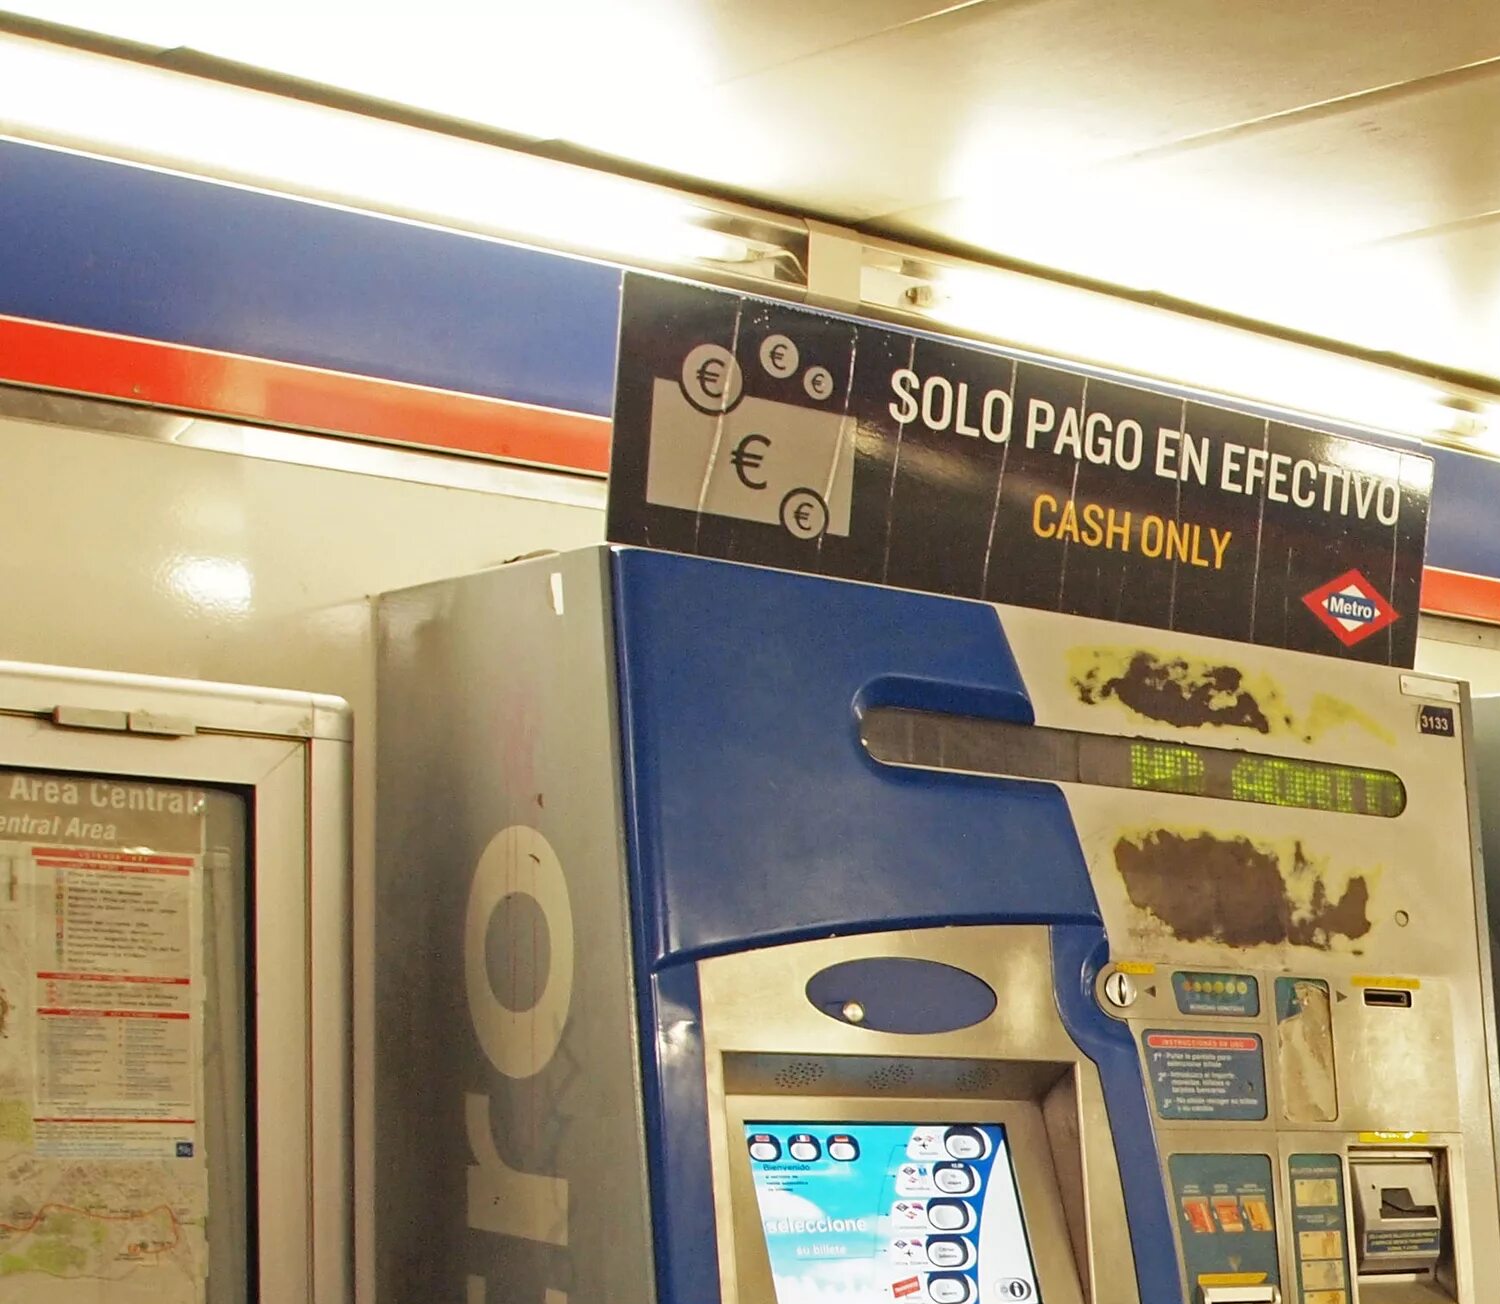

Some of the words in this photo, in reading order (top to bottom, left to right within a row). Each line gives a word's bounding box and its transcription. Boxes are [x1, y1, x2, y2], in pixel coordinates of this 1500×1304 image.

[889, 369, 1012, 443] SOLO
[1026, 398, 1143, 471] PAGO
[1155, 428, 1209, 485] EN
[1221, 442, 1400, 526] EFECTIVO
[1033, 494, 1131, 552] CASH
[1141, 515, 1232, 569] ONLY
[1329, 596, 1372, 618] Metro
[1422, 715, 1448, 730] 3133
[10, 775, 79, 805] Area
[65, 817, 116, 840] Area
[763, 1163, 810, 1171] Bienvenido
[813, 1244, 847, 1255] billete
